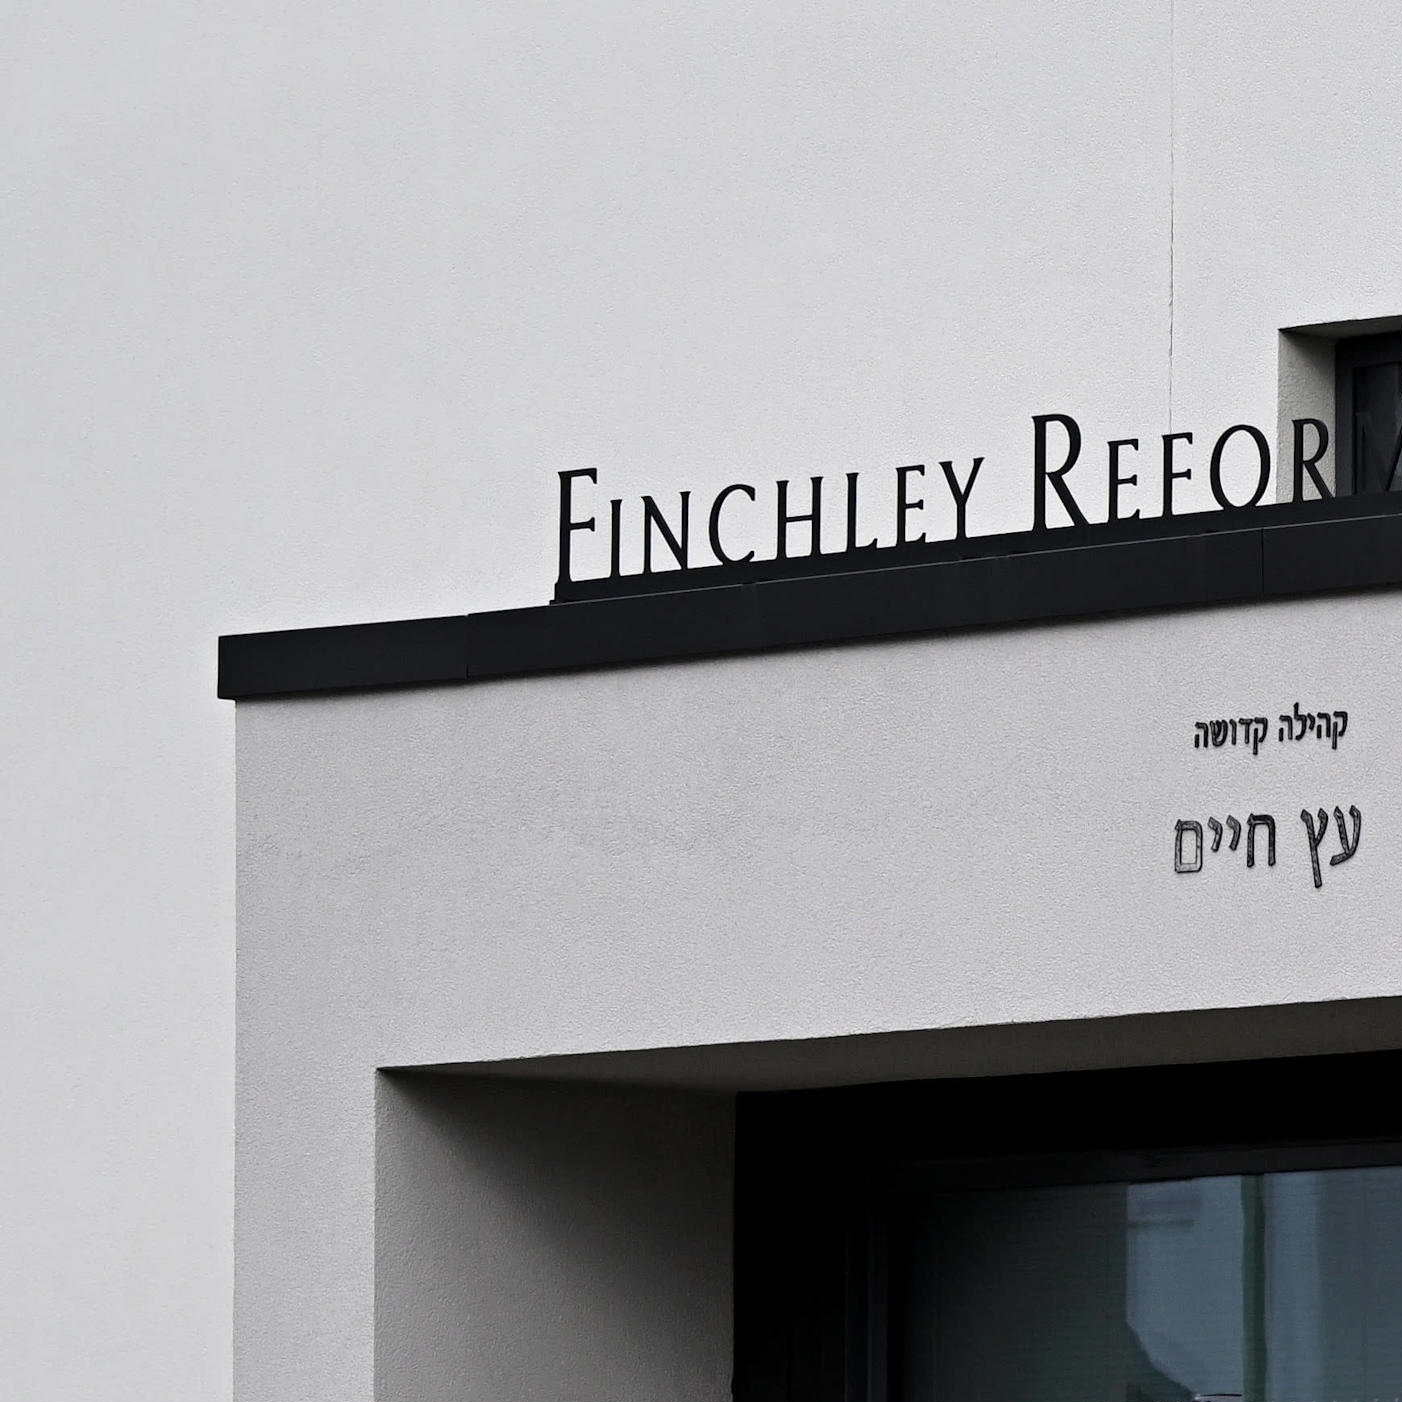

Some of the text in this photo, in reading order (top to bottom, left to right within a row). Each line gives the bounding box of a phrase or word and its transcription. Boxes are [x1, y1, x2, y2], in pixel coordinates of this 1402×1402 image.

[555, 456, 985, 584] FINCHLEY
[1194, 702, 1348, 756] קהילה קדושה
[1174, 804, 1362, 889] עץ חיים
